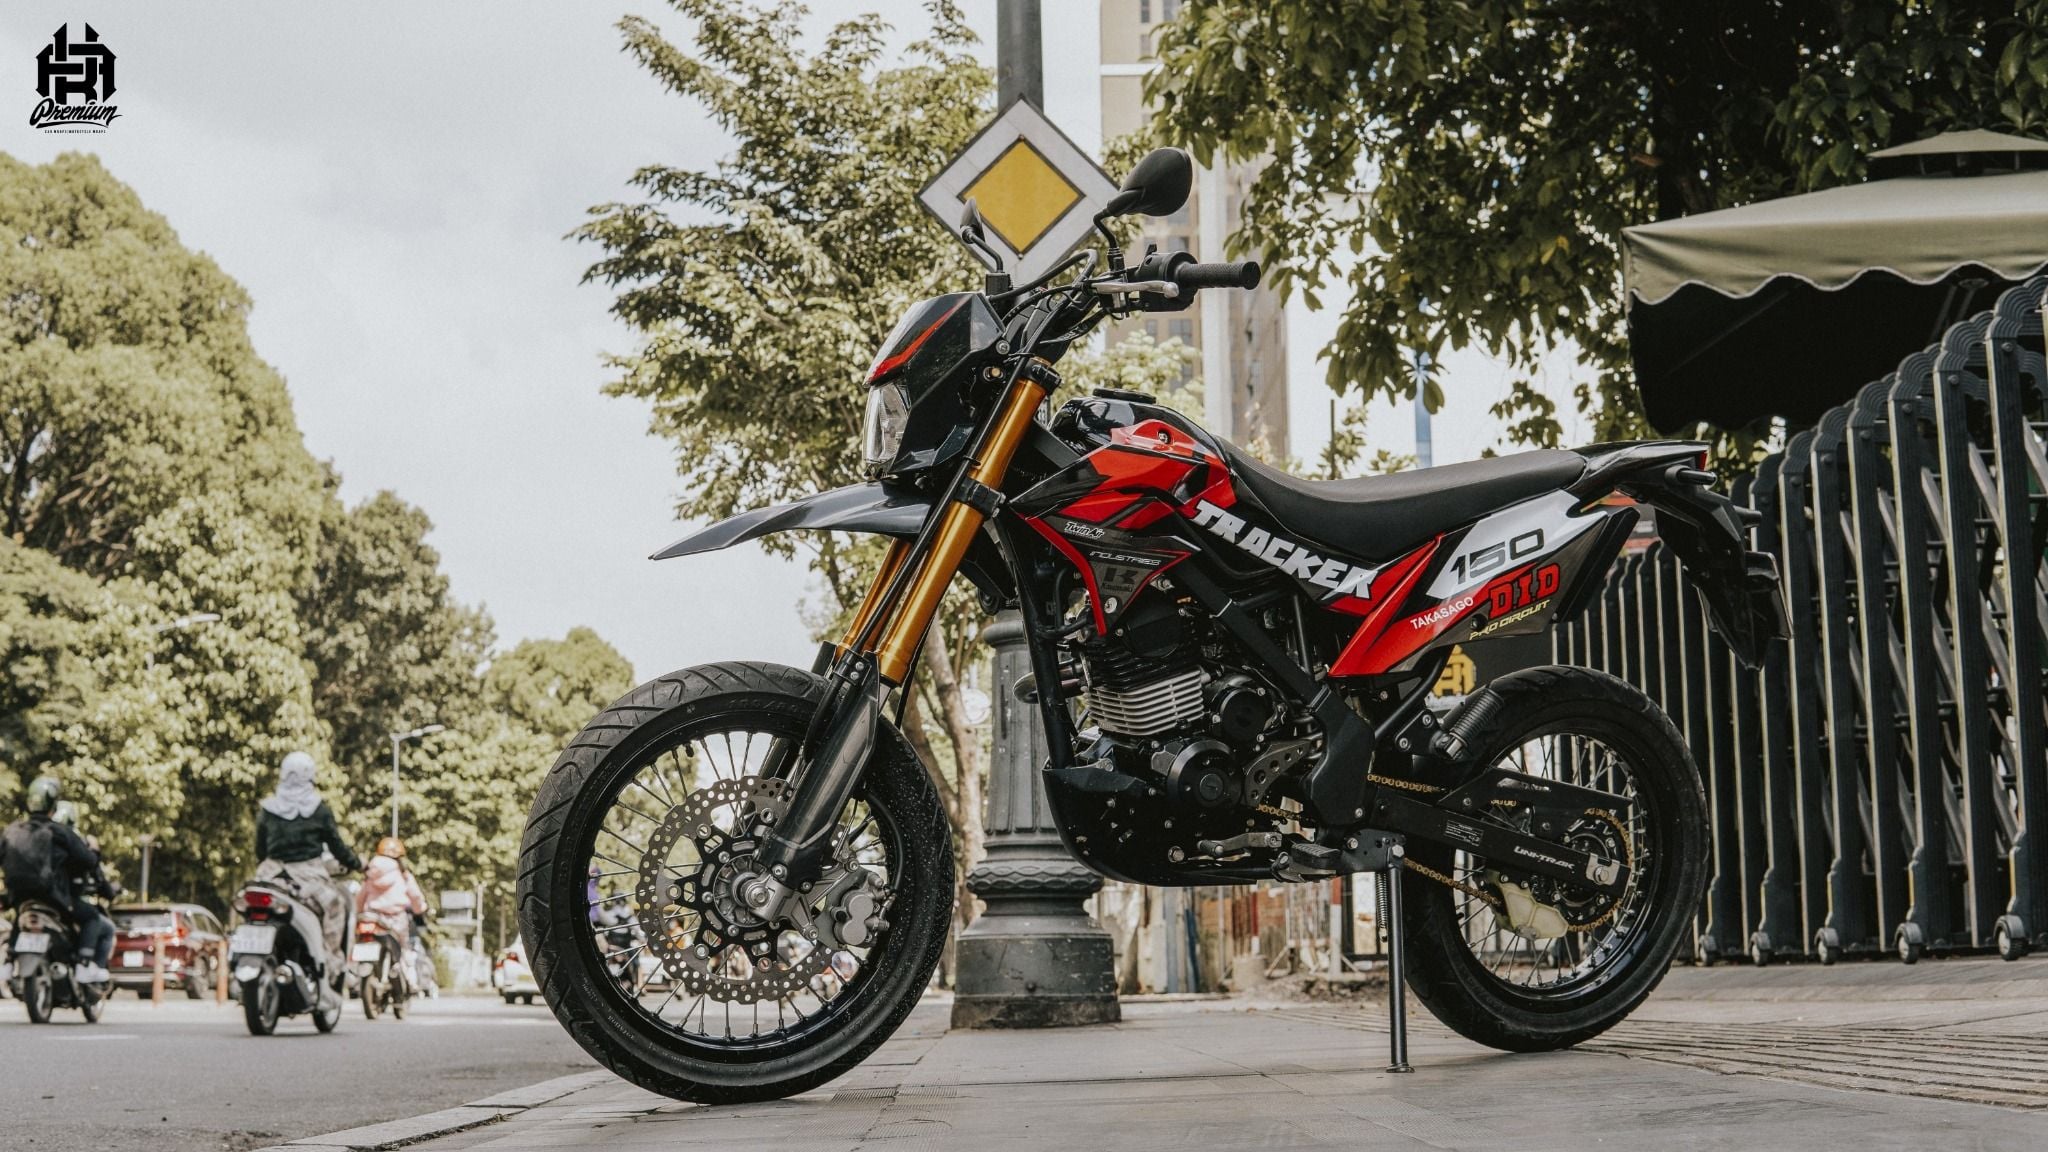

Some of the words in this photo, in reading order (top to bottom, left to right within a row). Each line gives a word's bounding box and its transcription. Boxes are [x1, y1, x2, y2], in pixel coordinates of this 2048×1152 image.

[1189, 499, 1379, 599] TRACKER
[1450, 528, 1545, 585] 150
[1410, 596, 1474, 630] TAKASAGO
[1469, 623, 1499, 641] PRO
[1499, 599, 1551, 628] CIRCUIT
